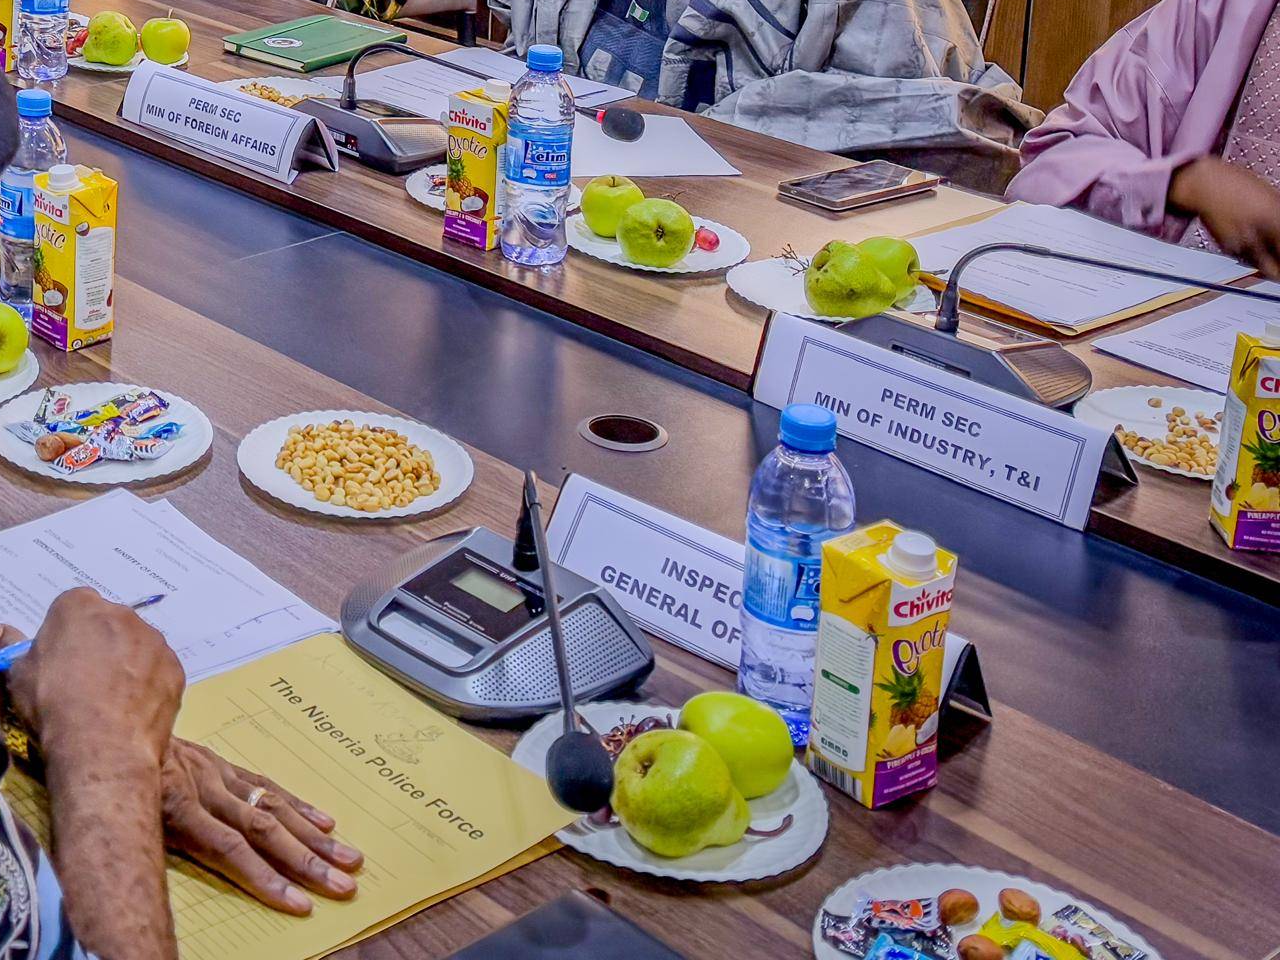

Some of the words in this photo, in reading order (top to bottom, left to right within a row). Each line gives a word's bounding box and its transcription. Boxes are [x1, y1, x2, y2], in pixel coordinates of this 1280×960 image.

[145, 103, 166, 119] MIN
[167, 110, 182, 124] OF
[184, 116, 229, 141] FOREIGN
[231, 132, 277, 156] AFFAIRS
[188, 97, 218, 118] PERM
[219, 105, 242, 123] SEC
[449, 110, 487, 131] Chivita
[448, 134, 488, 160] exotic
[34, 192, 64, 218] hivita
[34, 223, 66, 250] xotic
[880, 388, 937, 421] PERM
[941, 411, 982, 438] SEC
[814, 391, 851, 418] MIN
[856, 408, 883, 428] OF
[887, 419, 996, 478] INDUSTRY,
[1004, 464, 1041, 492] T&I
[600, 565, 702, 630] GENERAL
[711, 620, 741, 644] OF
[891, 620, 945, 677] exoti
[269, 676, 303, 706] The
[301, 703, 366, 758] Nigeria
[364, 755, 425, 801] Police
[424, 797, 485, 841] Force
